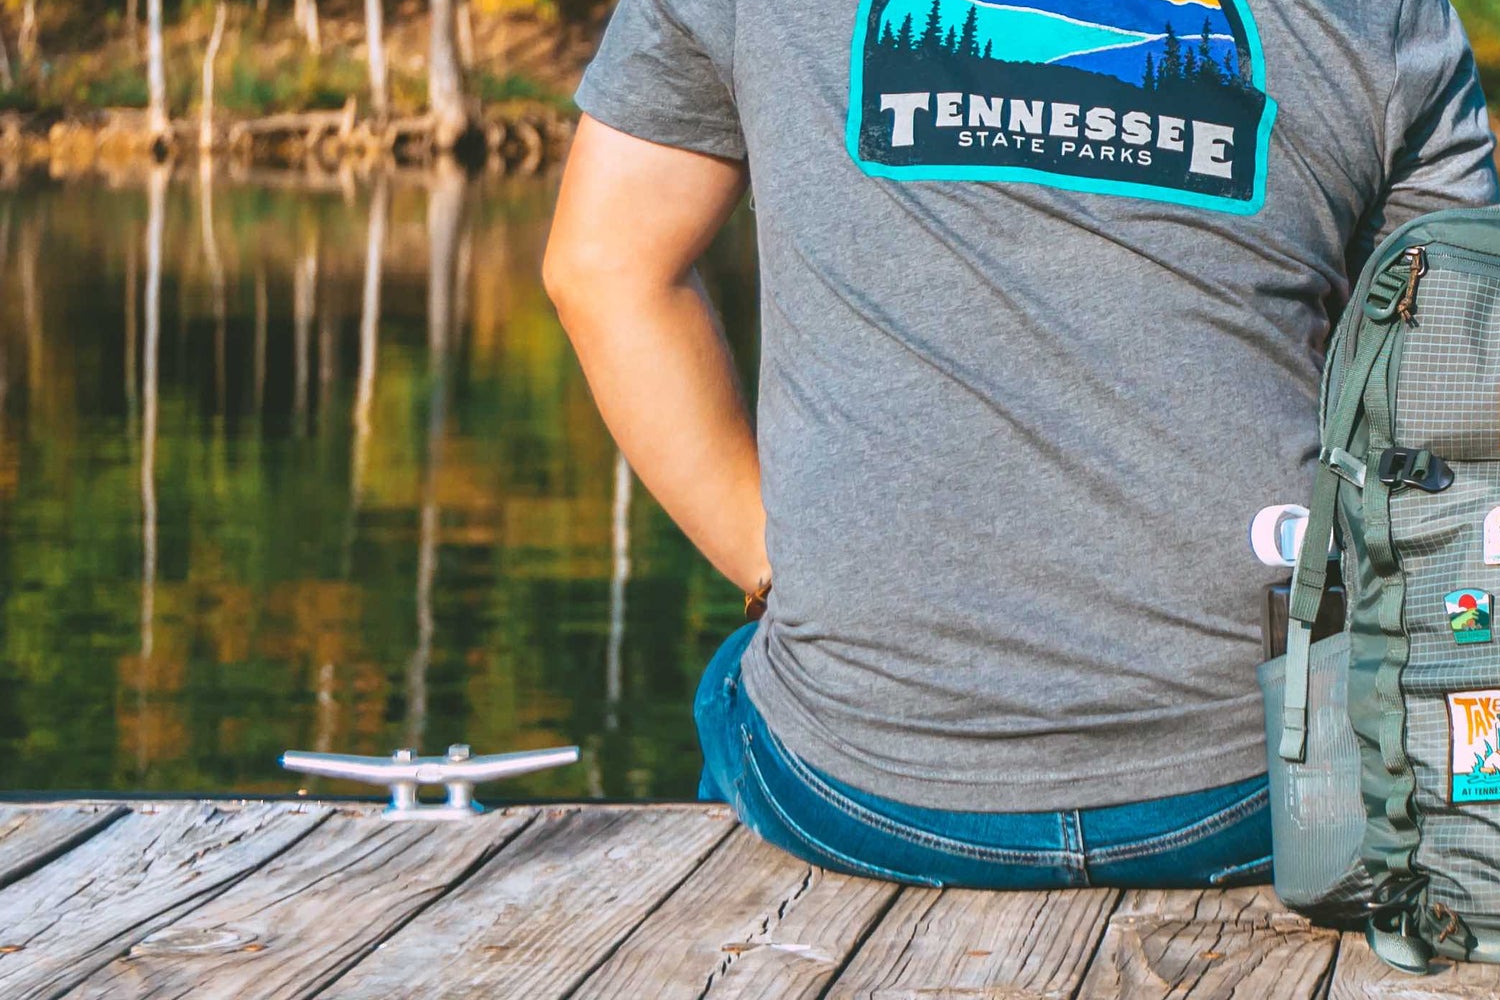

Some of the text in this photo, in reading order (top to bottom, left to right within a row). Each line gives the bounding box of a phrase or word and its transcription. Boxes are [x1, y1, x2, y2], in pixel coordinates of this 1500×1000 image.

[879, 91, 1235, 179] TENNESSEE
[957, 130, 1153, 166] STATE PARKS
[1461, 787, 1472, 796] AT
